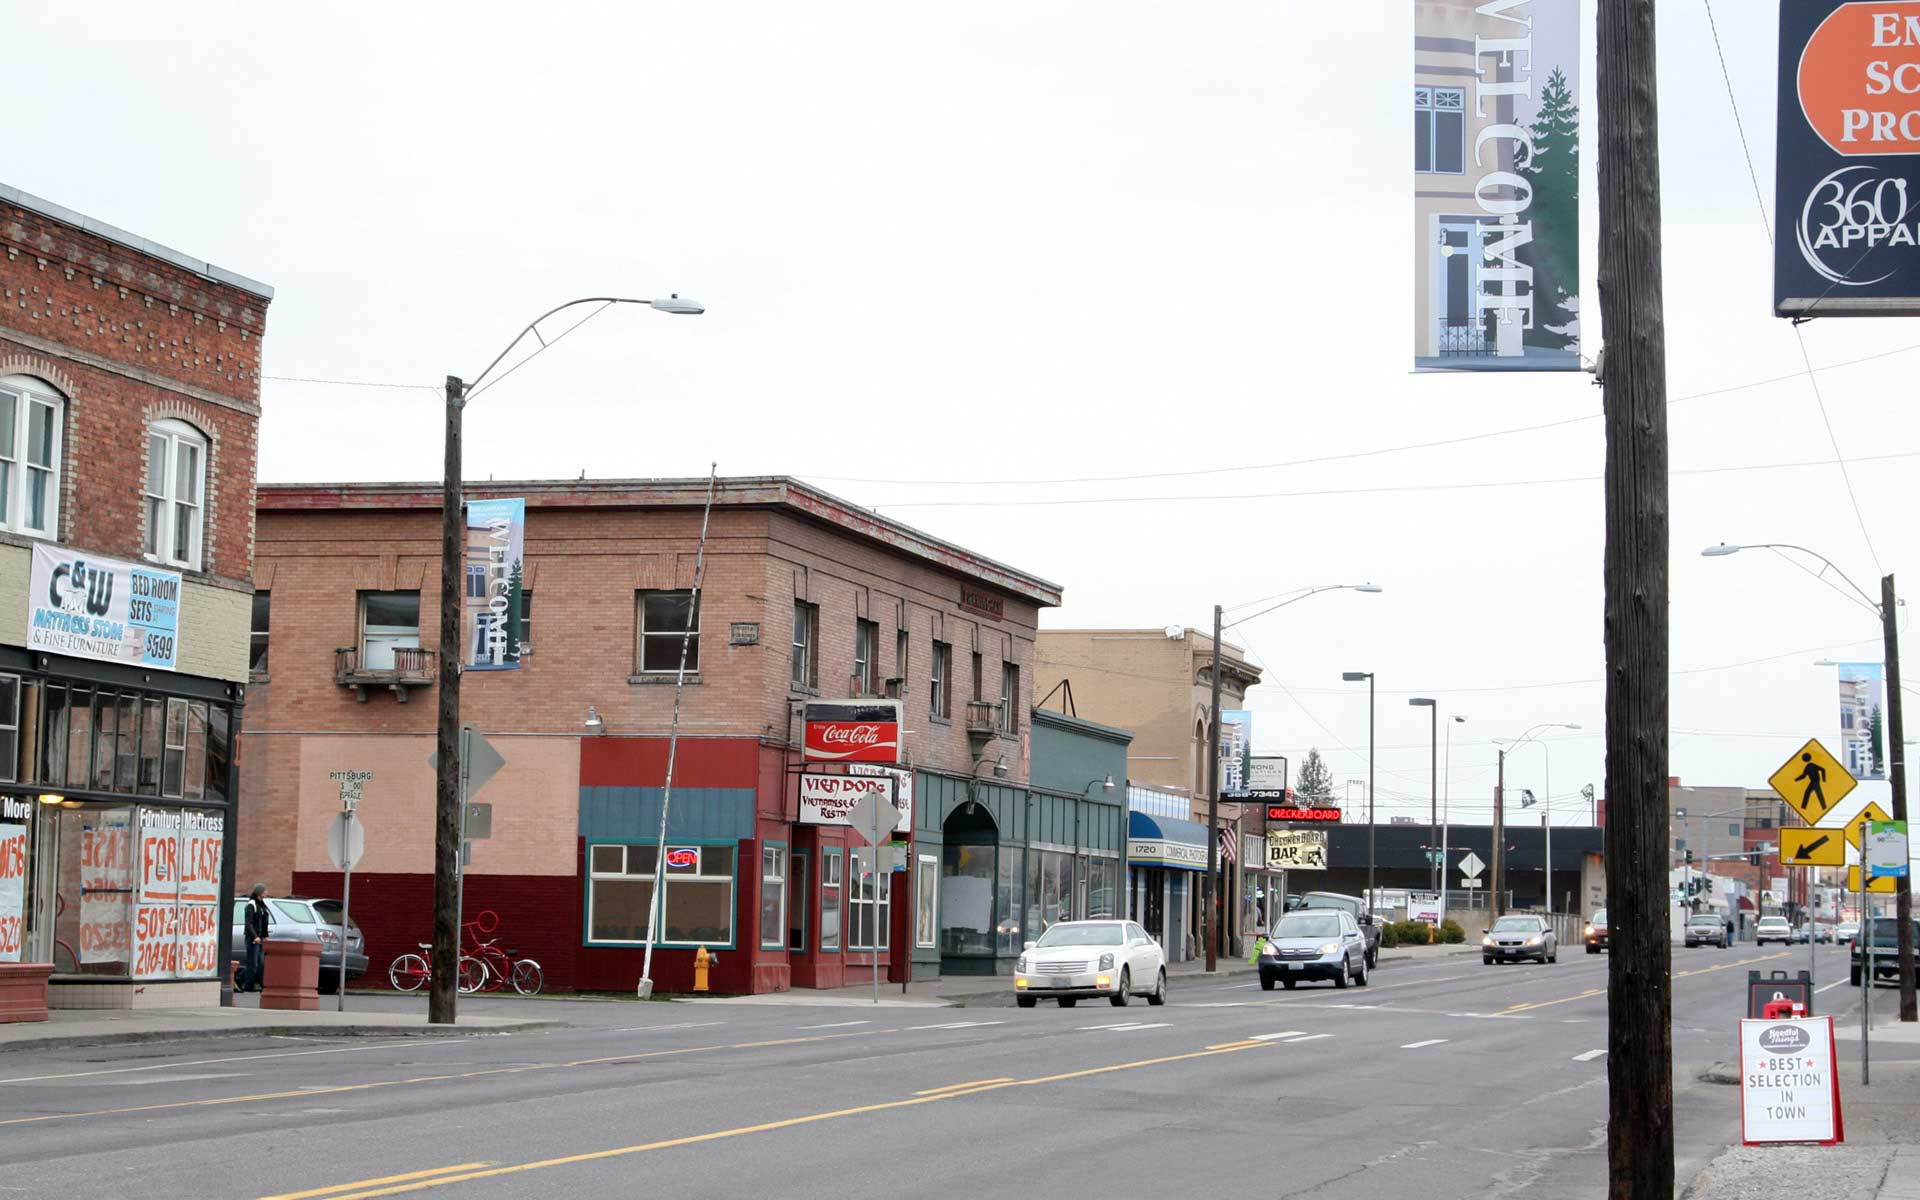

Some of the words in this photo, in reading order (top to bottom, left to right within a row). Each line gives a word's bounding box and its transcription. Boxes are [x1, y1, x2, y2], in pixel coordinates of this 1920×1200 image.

[1813, 222, 1920, 250] APPA
[132, 574, 149, 596] BED
[151, 577, 177, 601] ROOM
[487, 517, 512, 656] WELCOME
[33, 608, 90, 635] MATTRESS
[130, 599, 152, 622] SETS
[33, 628, 42, 644] &
[44, 630, 65, 647] FINE
[67, 634, 119, 657] FURNITURE
[146, 633, 173, 660] $599
[4, 797, 30, 819] More
[140, 807, 180, 830] Furniture
[184, 812, 223, 831] Mattress
[1269, 808, 1340, 819] CHECKERBOARD
[144, 837, 177, 885] FOR
[182, 837, 221, 884] LEASE
[667, 852, 697, 864] OPEN
[1271, 847, 1297, 860] BAR
[1769, 1058, 1801, 1070] BEST
[1749, 1074, 1821, 1088] SELECTION
[1781, 1091, 1793, 1102] IN
[1767, 1106, 1806, 1119] TOWN
